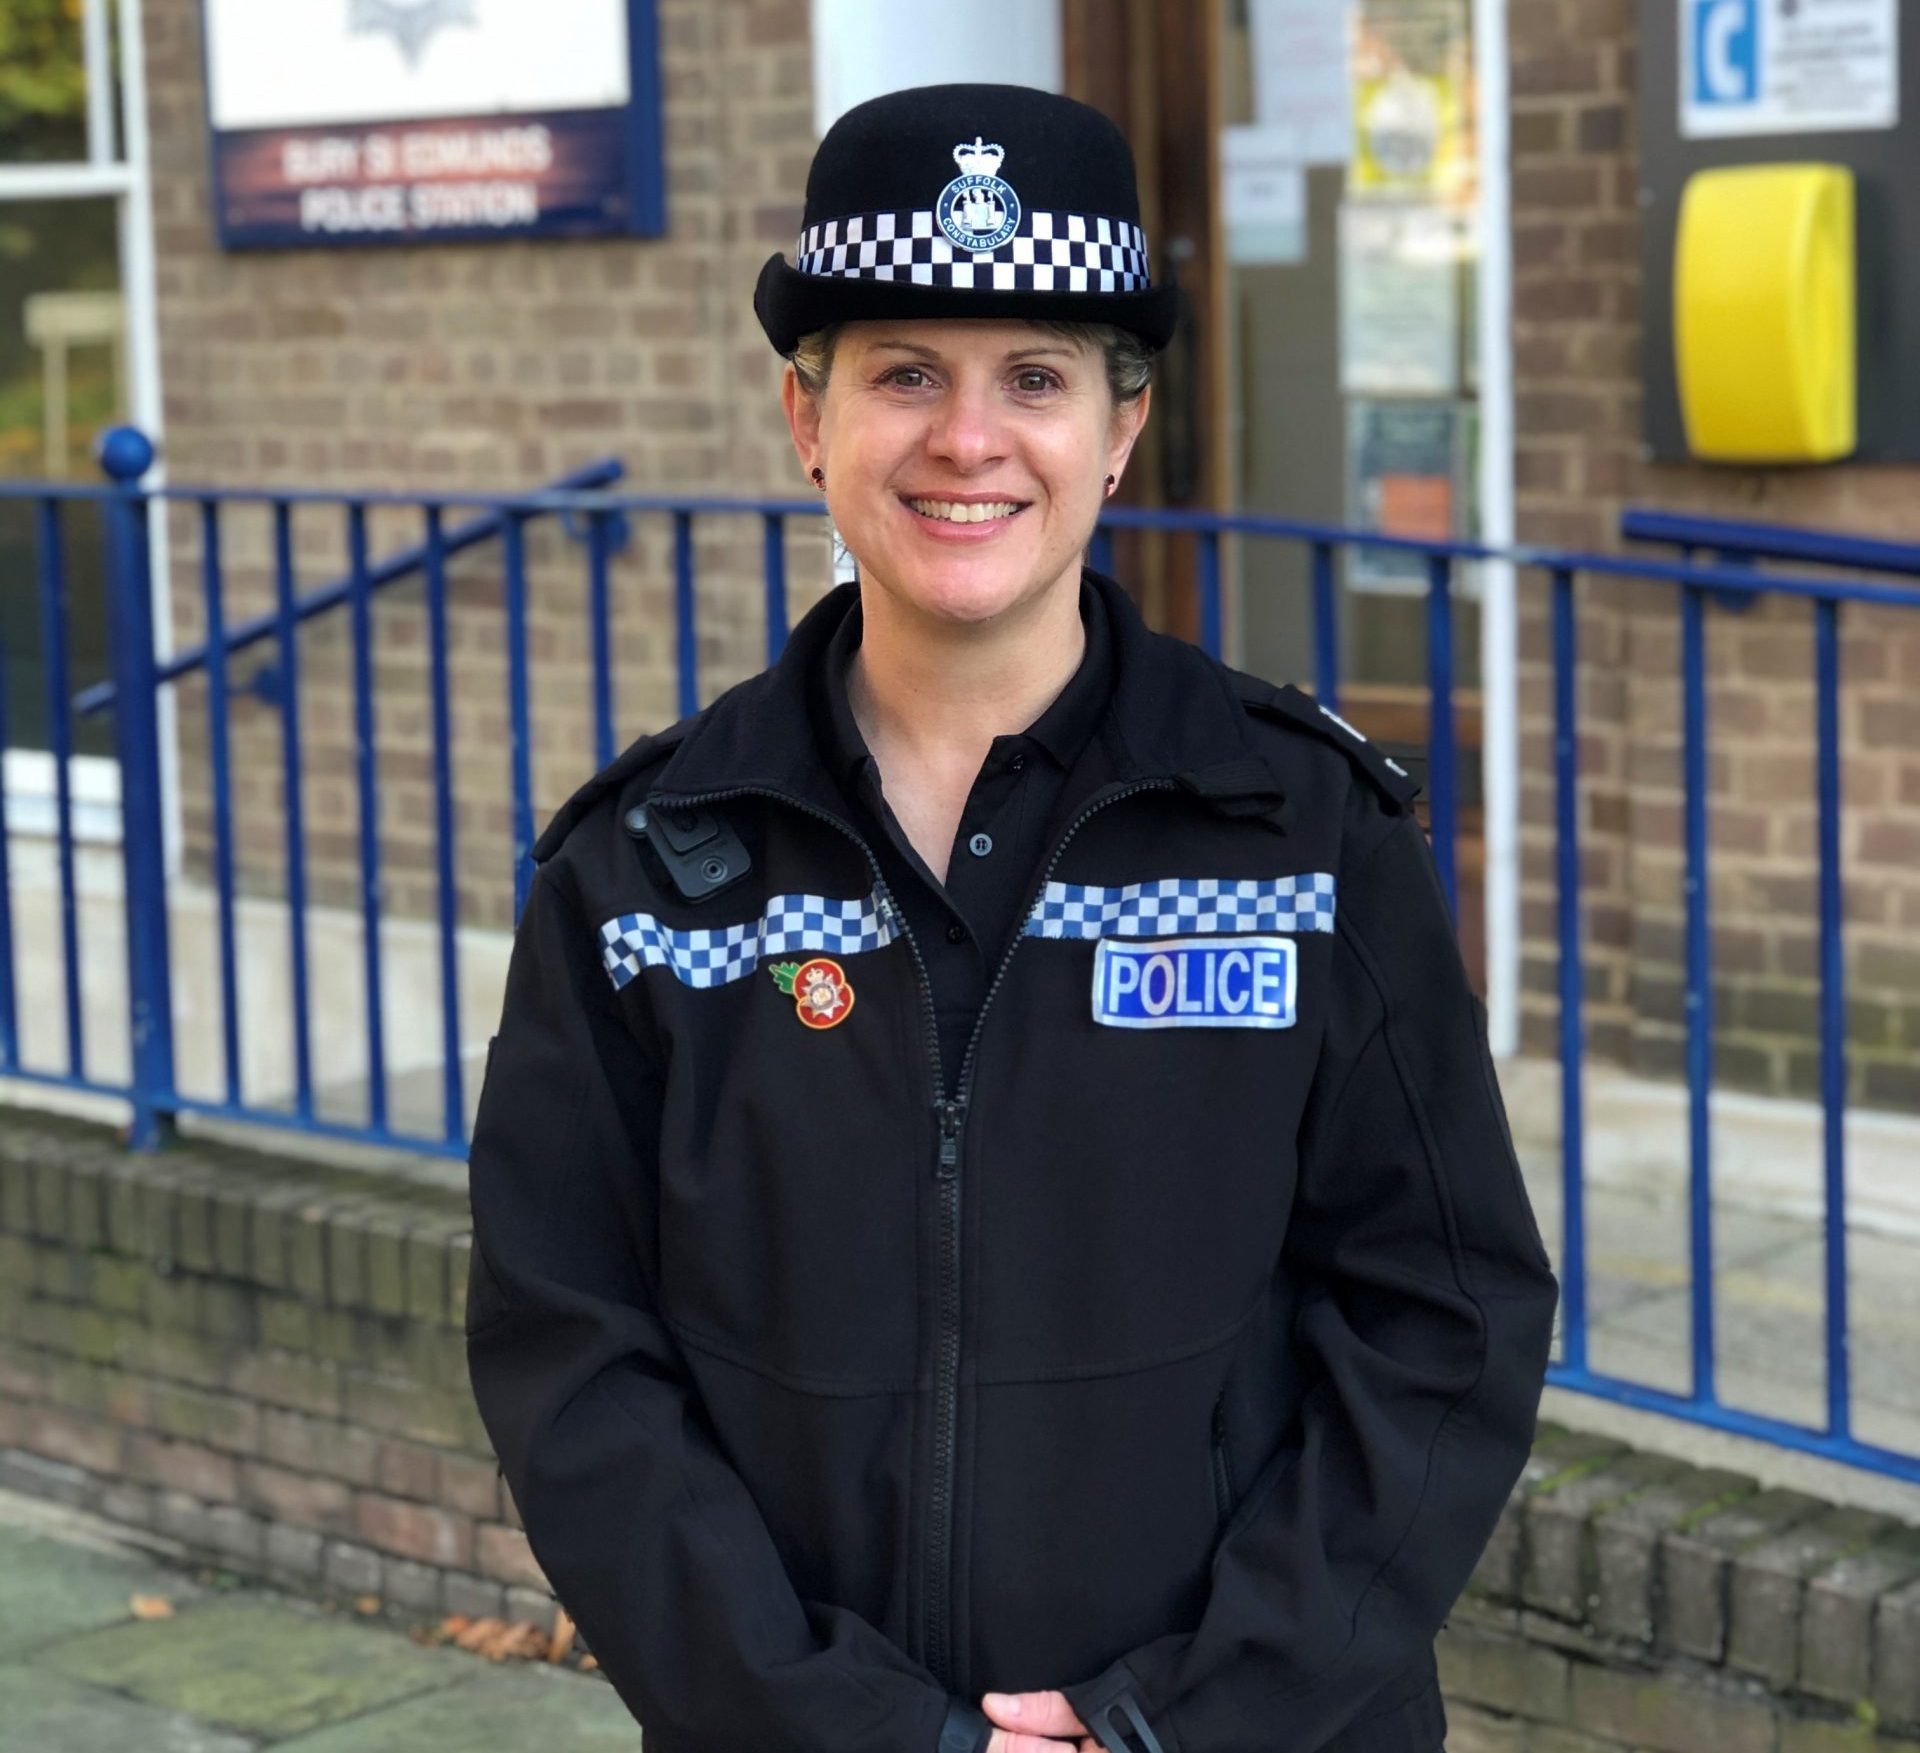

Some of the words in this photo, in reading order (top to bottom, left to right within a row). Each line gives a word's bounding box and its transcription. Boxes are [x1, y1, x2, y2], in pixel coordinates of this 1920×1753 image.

[284, 139, 358, 183] BURY
[402, 125, 552, 176] EDMUNDS
[301, 188, 405, 232] POLICE
[411, 182, 538, 228] STATION
[951, 176, 1006, 194] SUFFOLK
[943, 217, 1016, 248] CONSTABULARY
[1109, 951, 1281, 1015] POLICE
